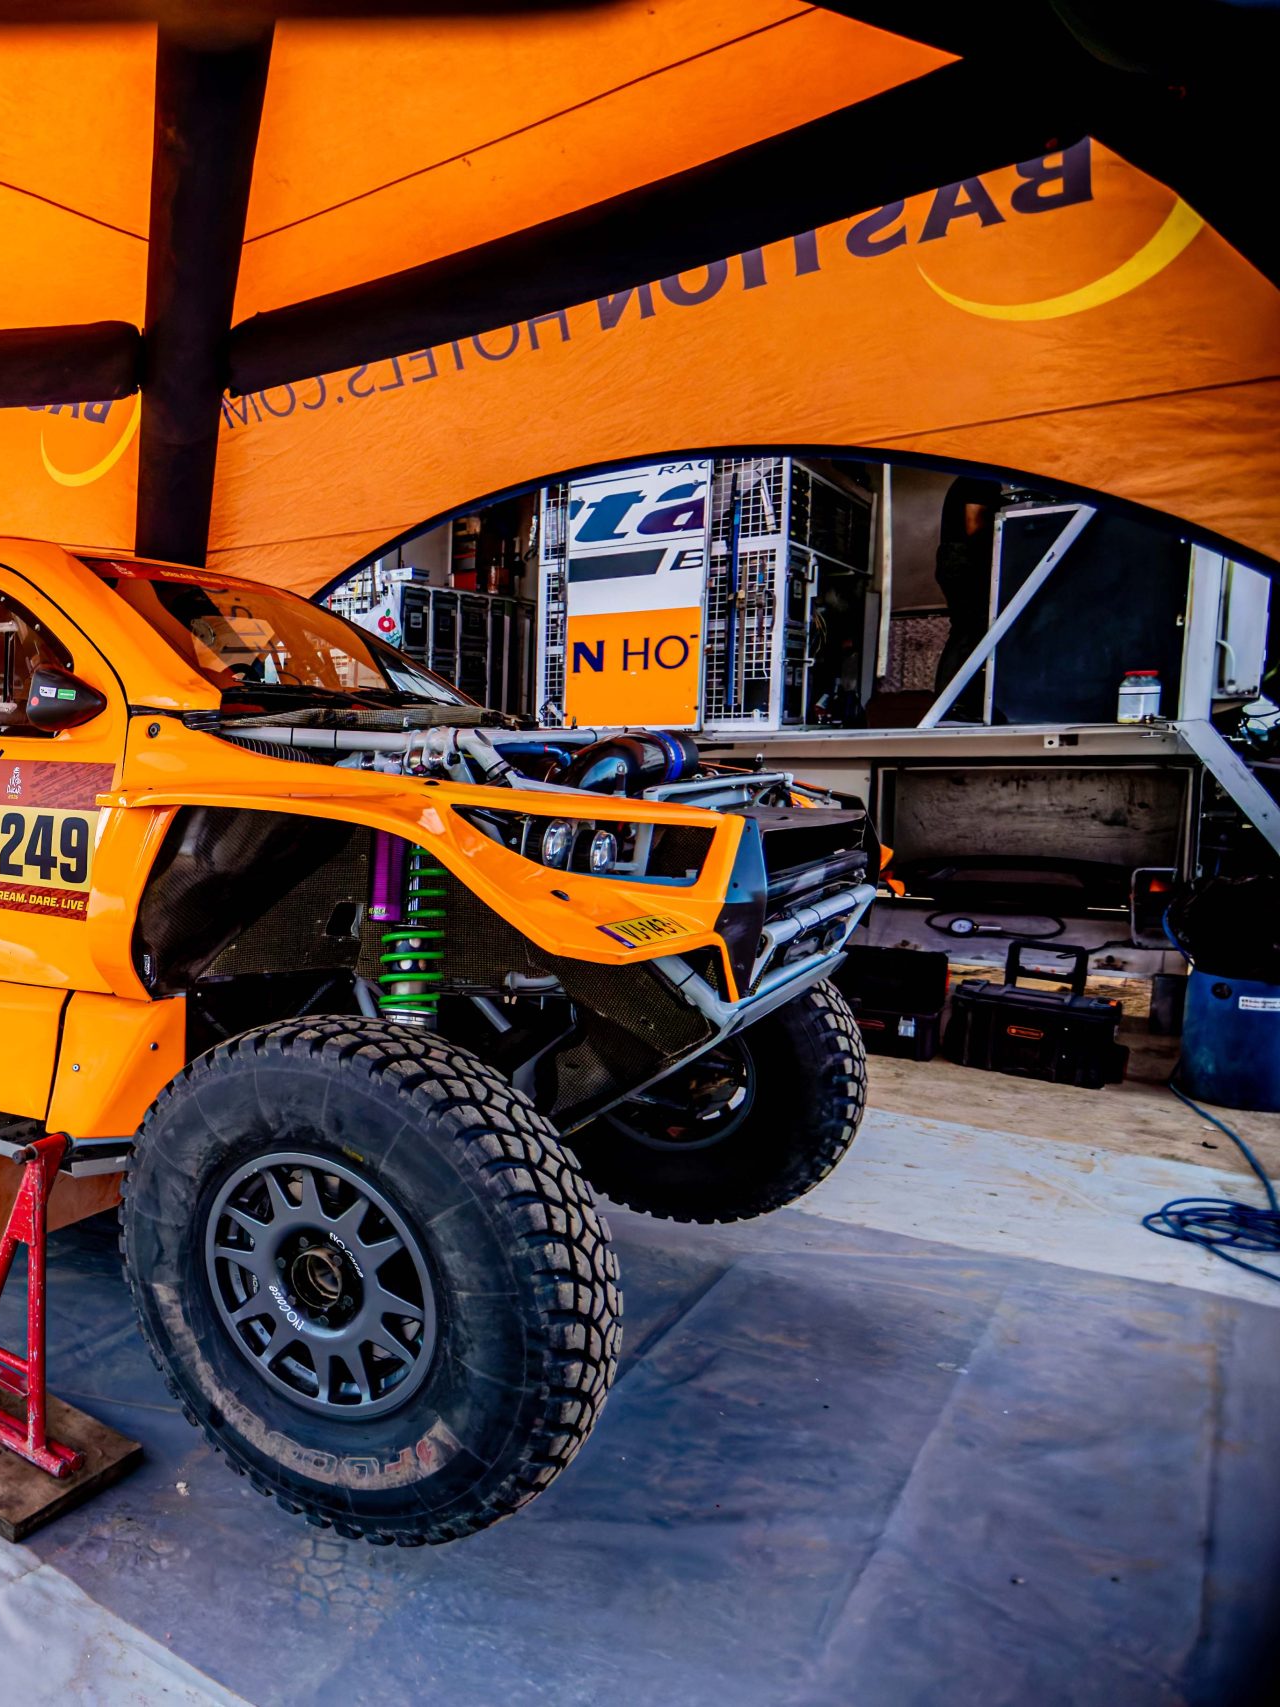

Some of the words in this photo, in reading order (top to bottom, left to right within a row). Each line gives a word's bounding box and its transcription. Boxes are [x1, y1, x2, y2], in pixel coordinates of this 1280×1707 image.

[622, 634, 699, 671] HO
[28, 894, 59, 907] DARE.
[61, 898, 84, 911] LIVE
